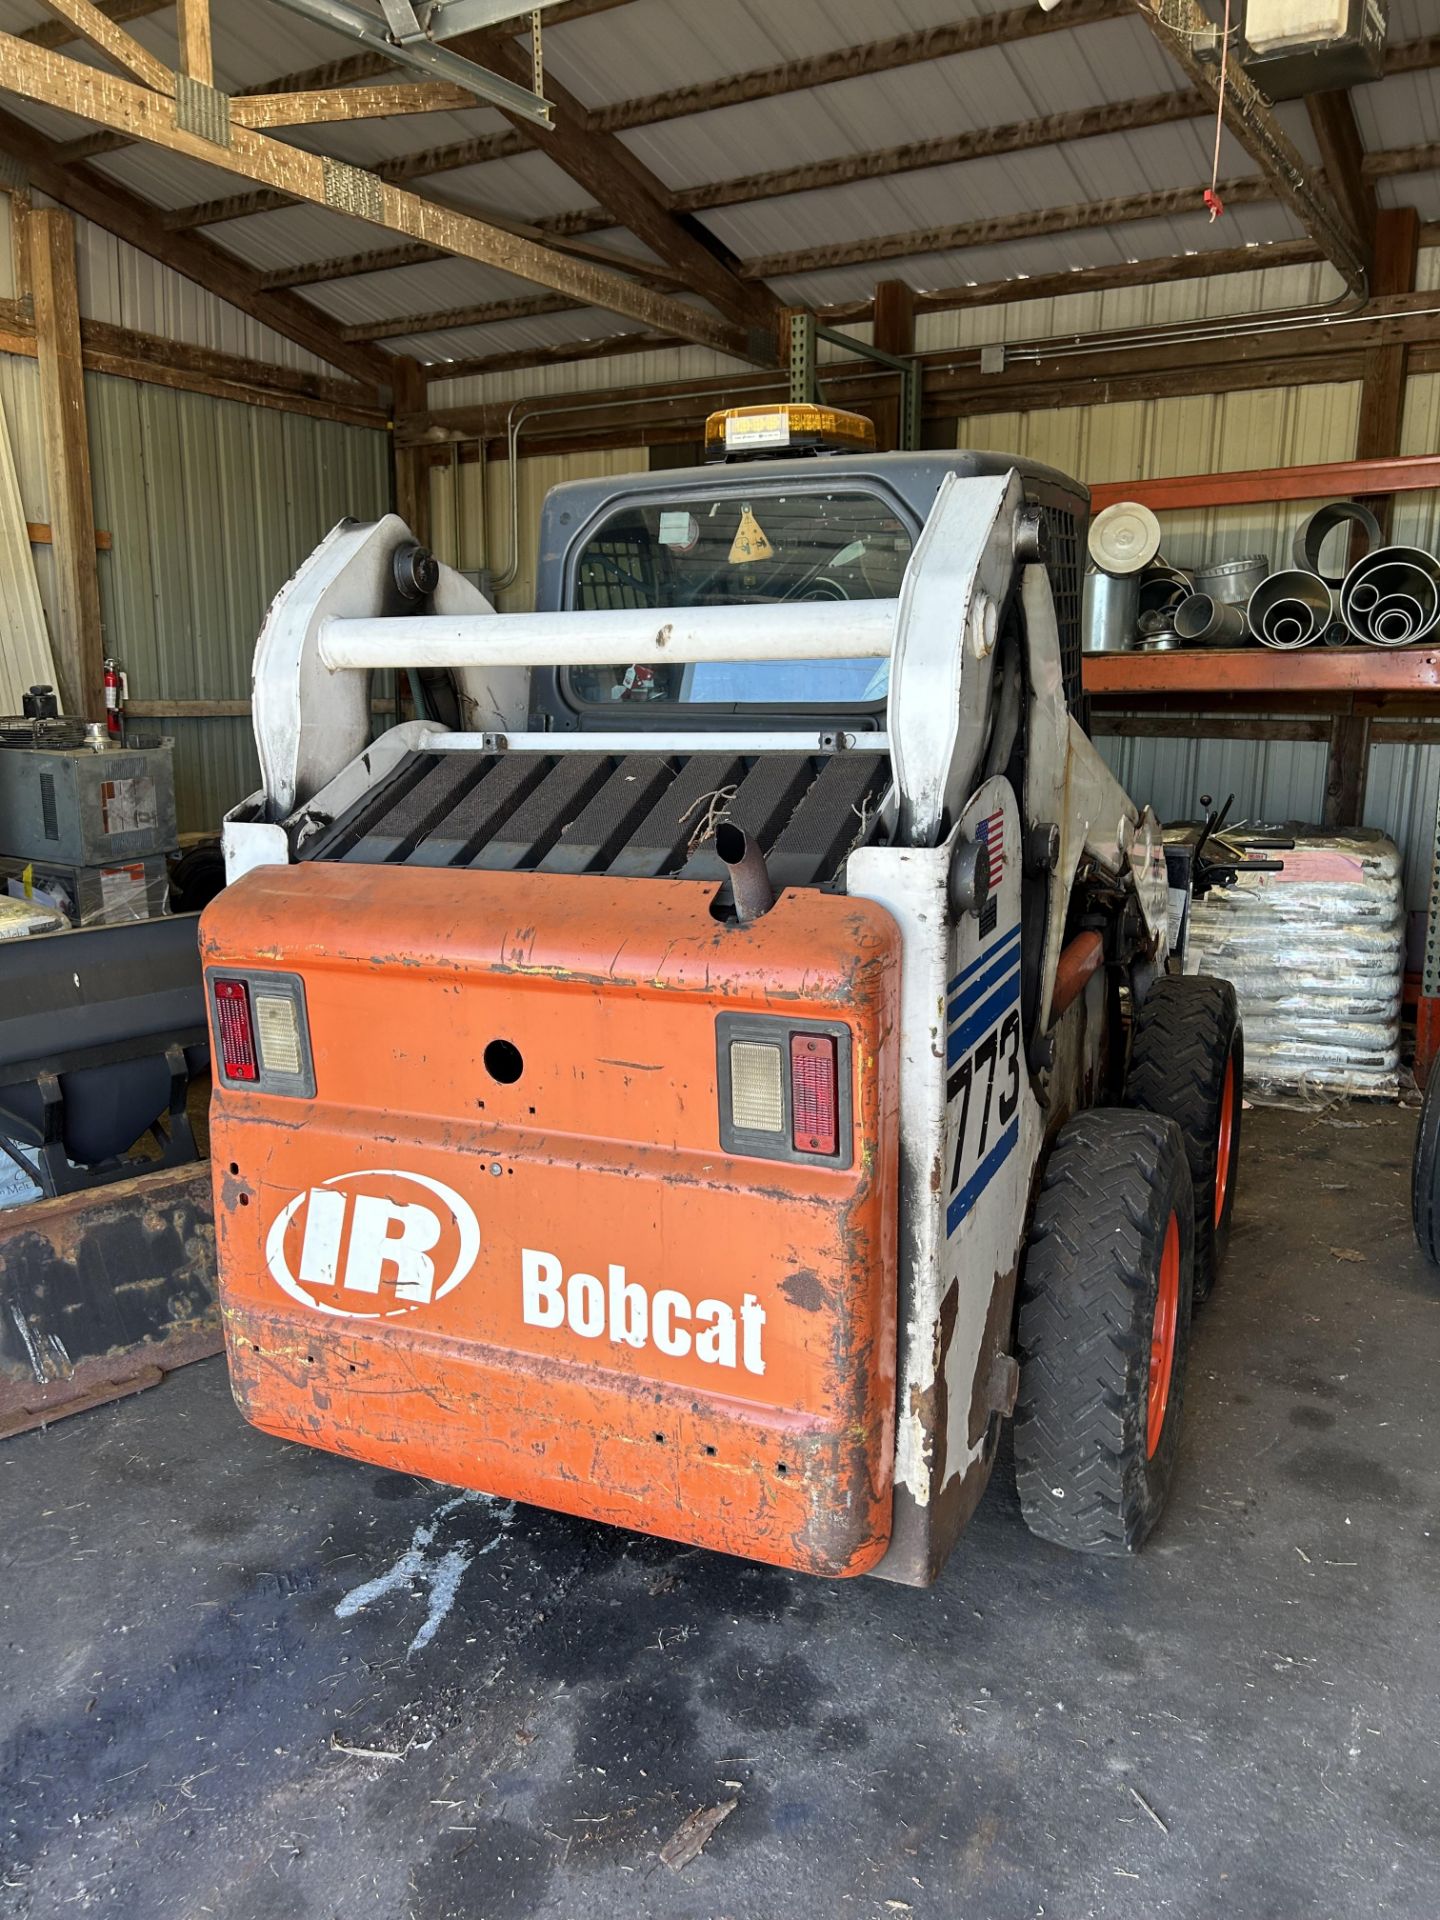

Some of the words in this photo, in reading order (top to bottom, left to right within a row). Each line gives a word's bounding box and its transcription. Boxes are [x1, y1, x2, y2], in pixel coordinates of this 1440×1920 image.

[946, 1007, 1020, 1196] 773
[6, 1182, 31, 1196] Melt
[298, 1187, 441, 1304] IR
[521, 1248, 767, 1376] Bobcat
